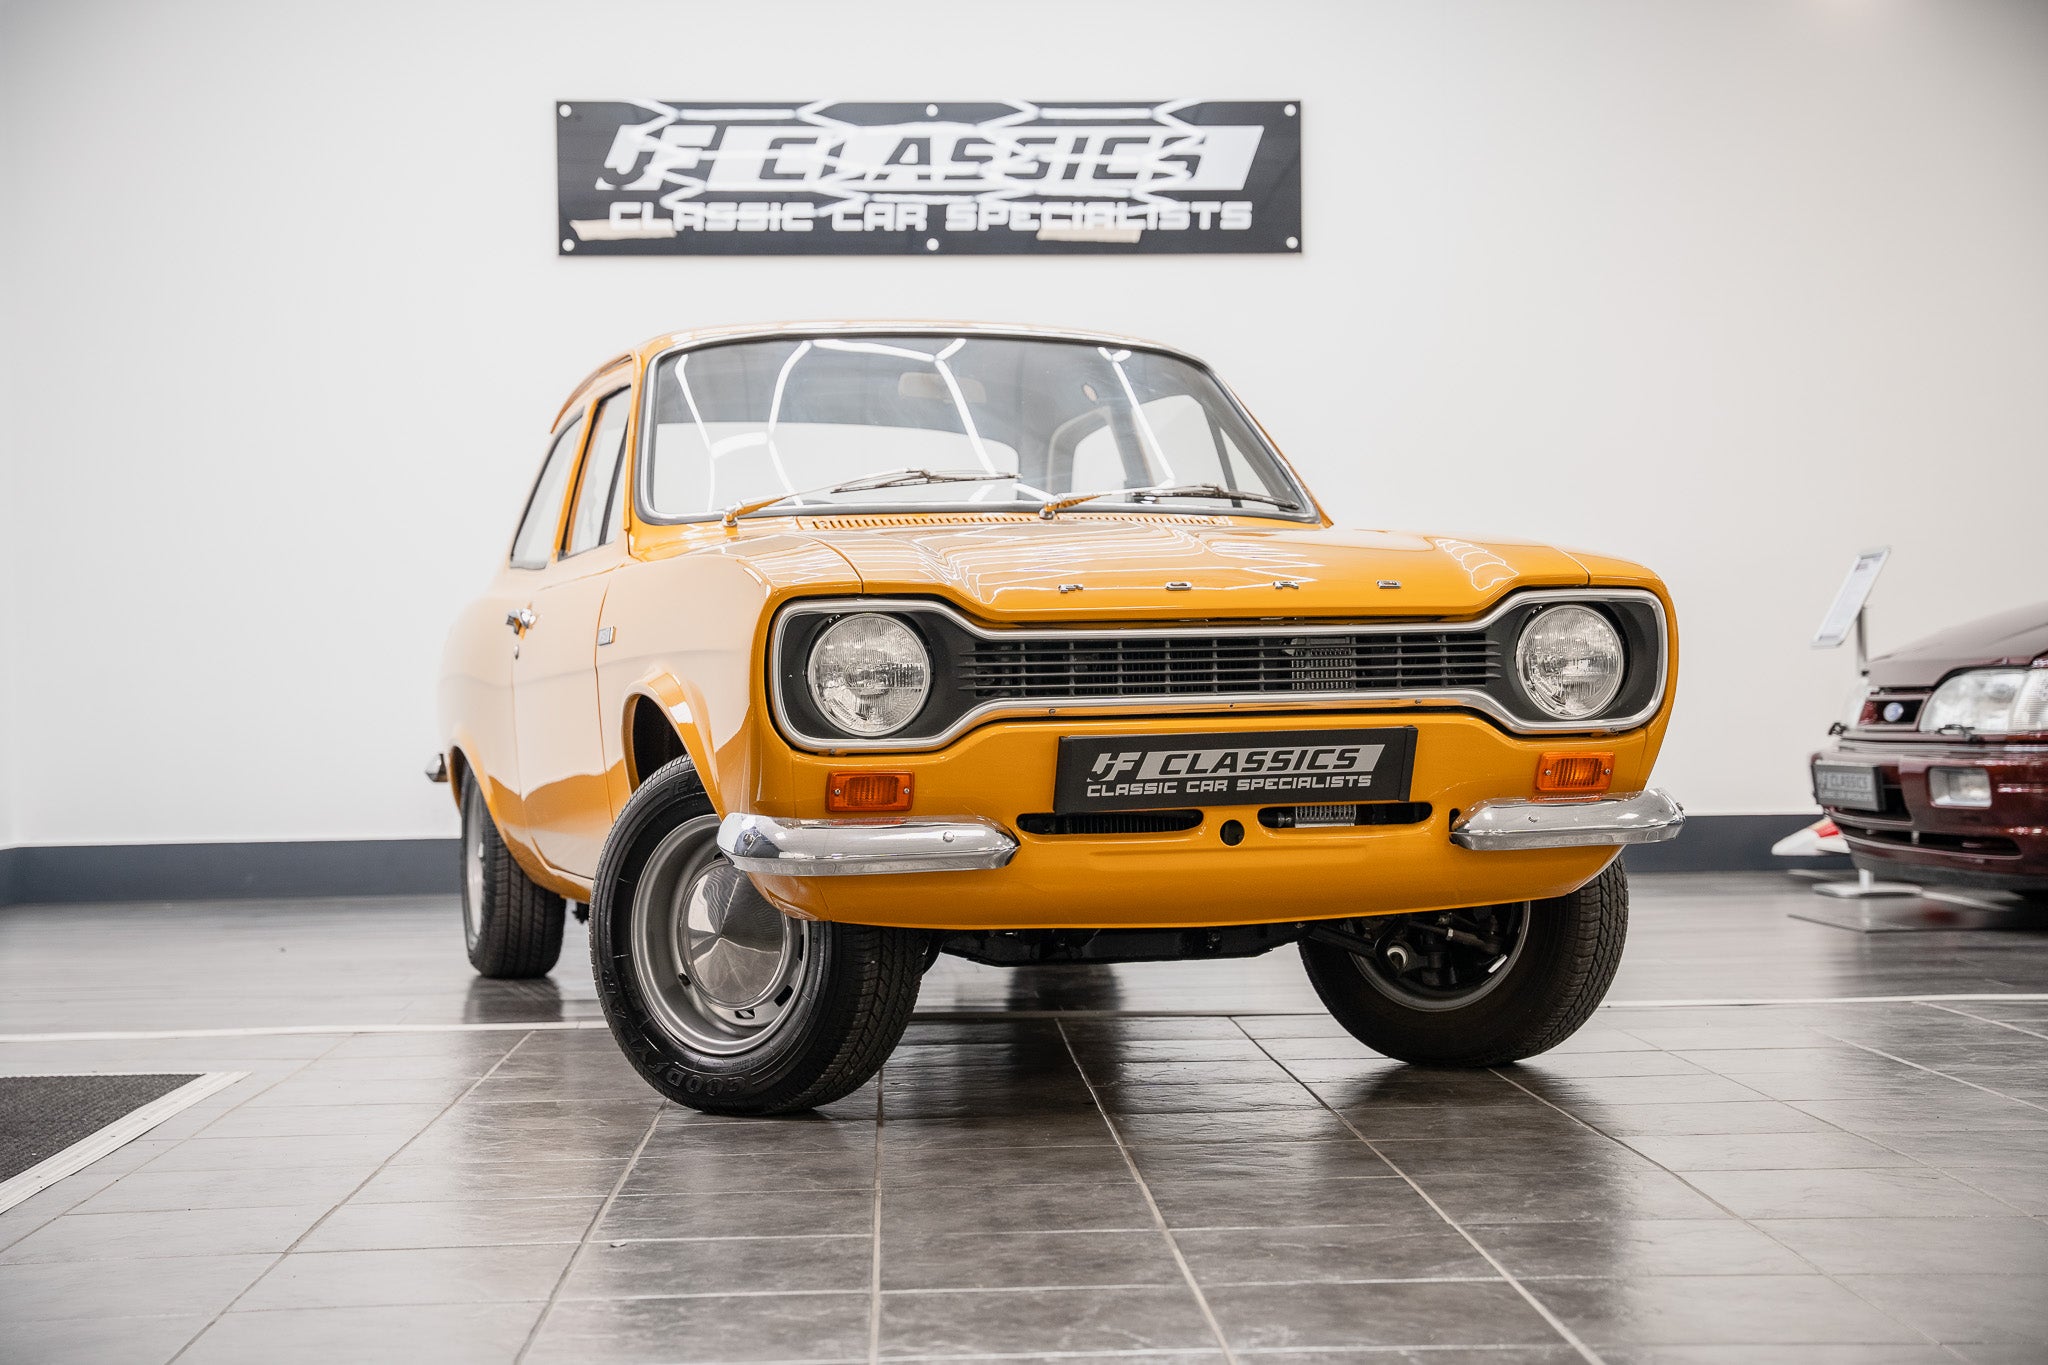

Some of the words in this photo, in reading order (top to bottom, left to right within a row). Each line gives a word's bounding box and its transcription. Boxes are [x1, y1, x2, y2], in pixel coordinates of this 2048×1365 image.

[758, 135, 1204, 181] CLASSICS
[609, 201, 815, 232] CLASSIC
[831, 201, 928, 232] CAR
[944, 201, 1253, 232] SPECIALISTS
[1086, 751, 1143, 782] JF
[1158, 747, 1362, 776] CLASSICS
[1086, 781, 1178, 797] CLASSIC
[1186, 779, 1229, 793] CAR
[1236, 774, 1372, 791] SPECIALISTS
